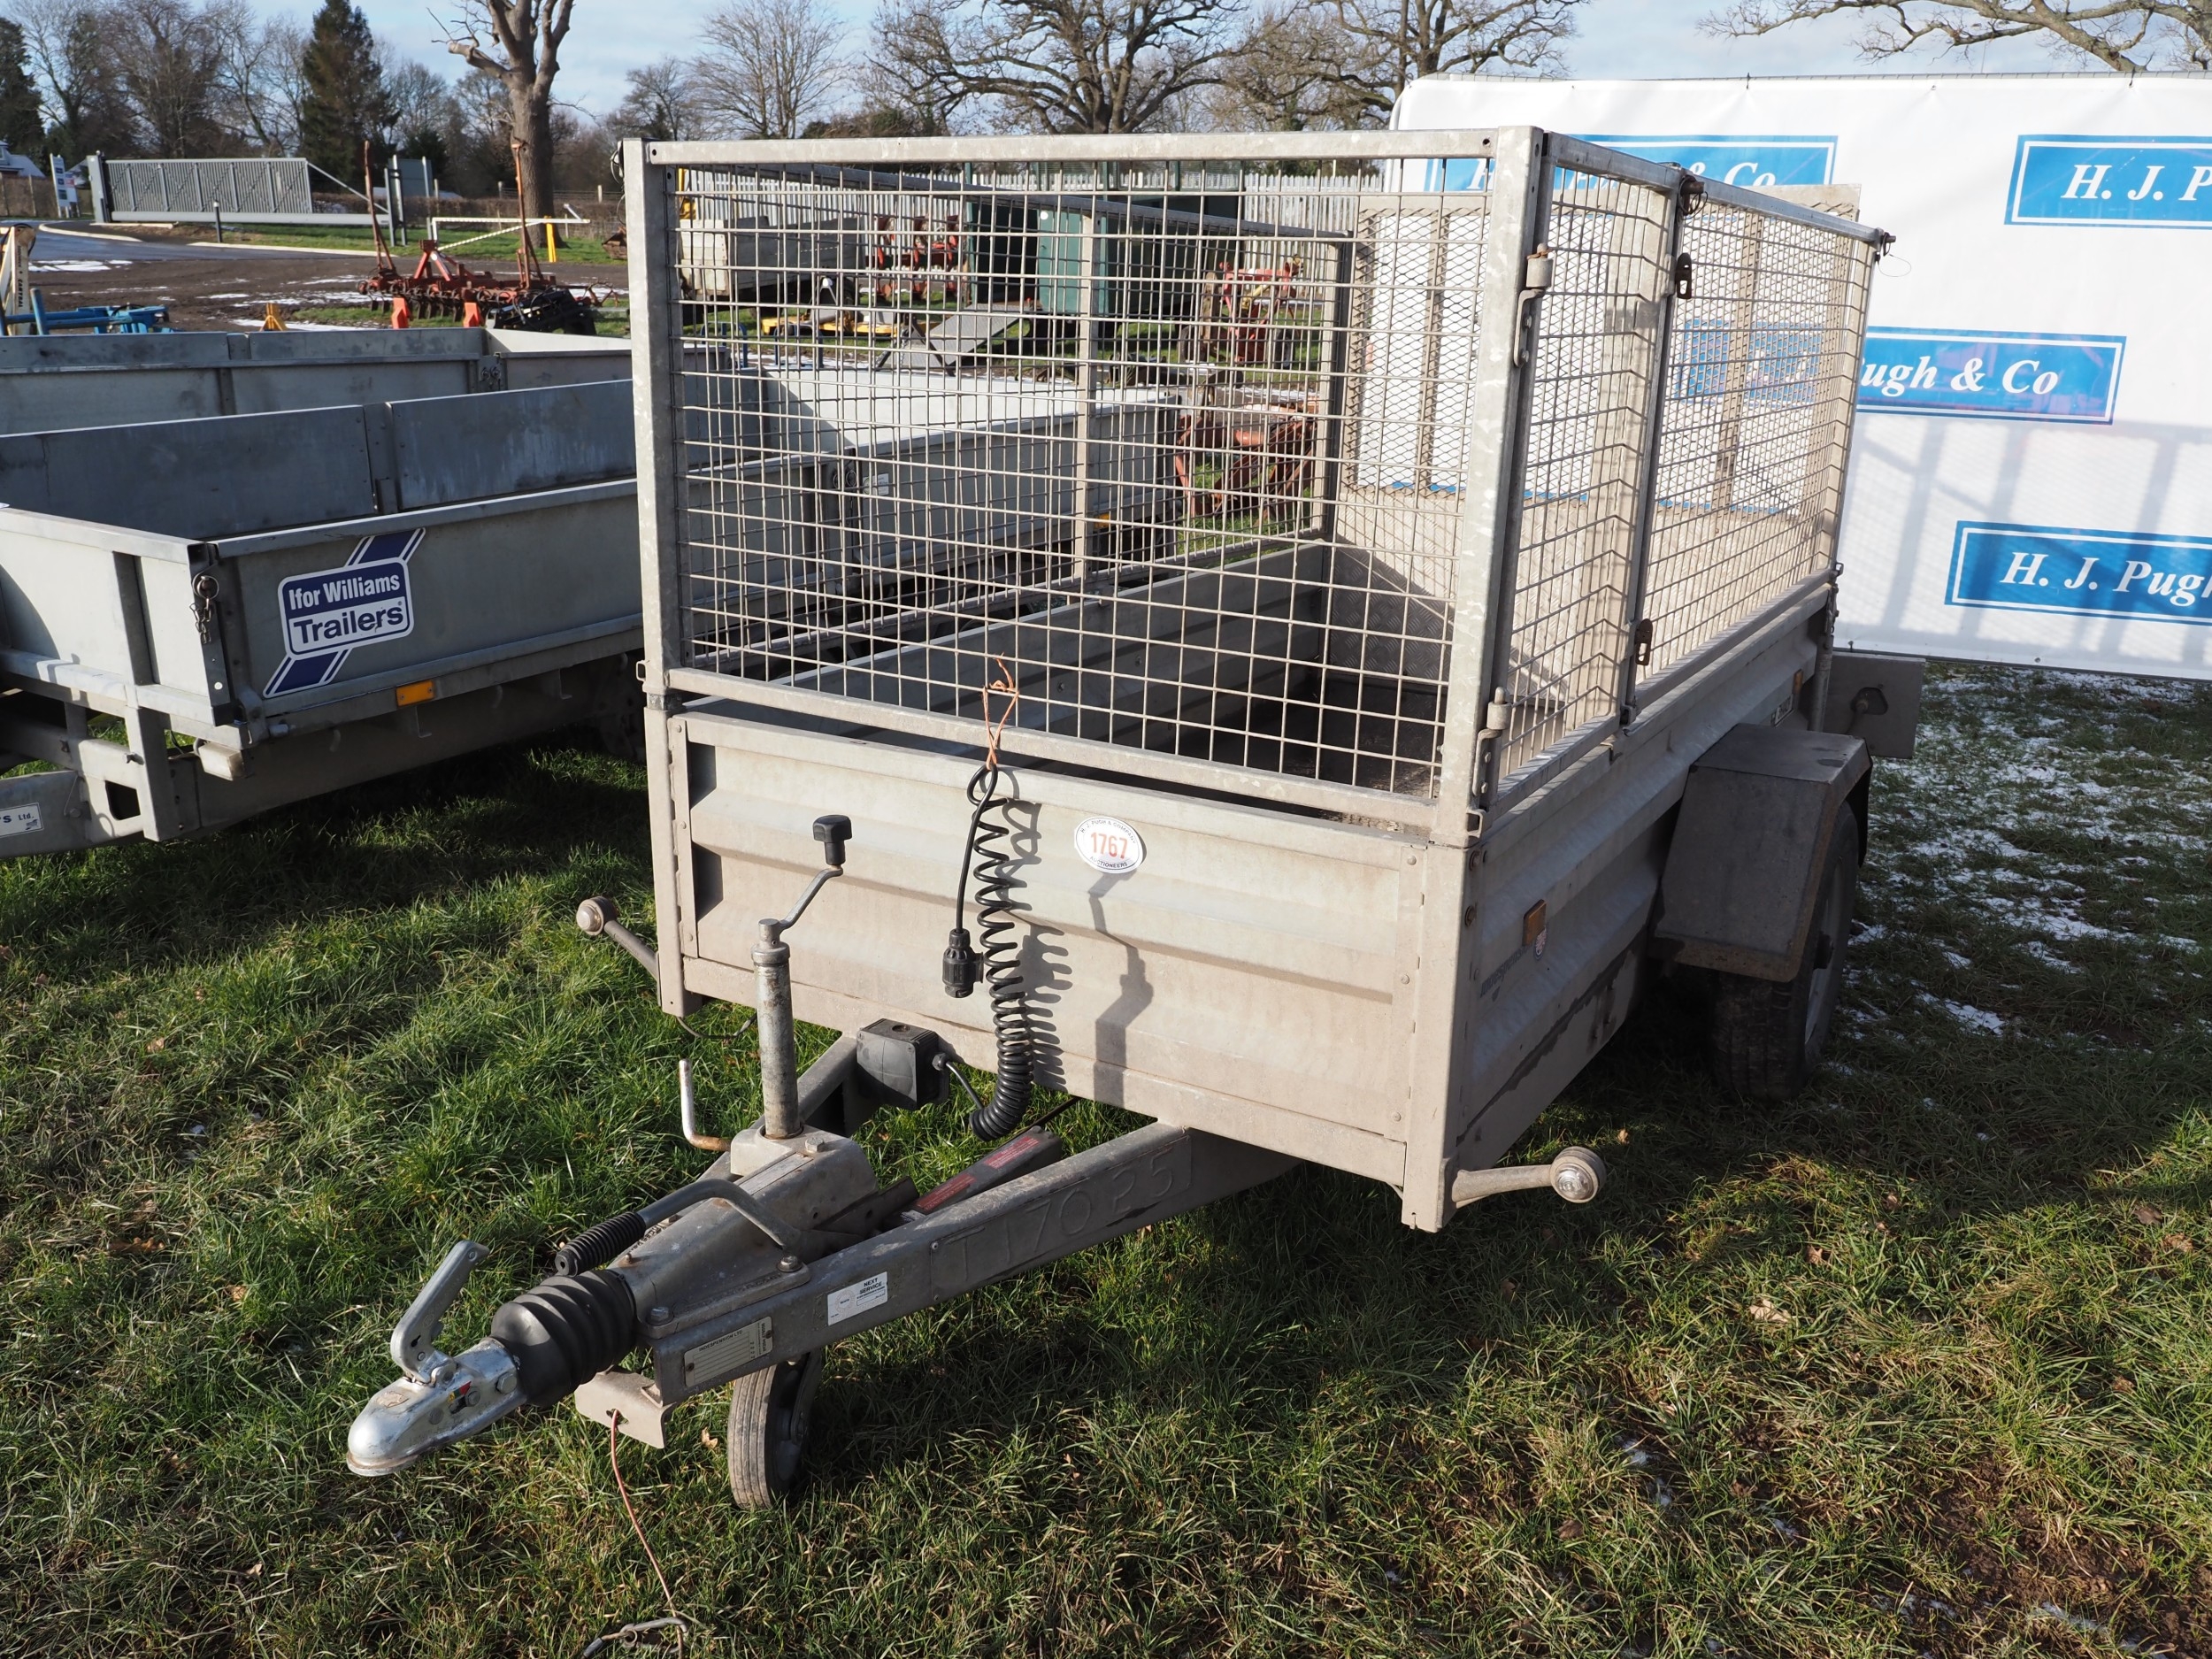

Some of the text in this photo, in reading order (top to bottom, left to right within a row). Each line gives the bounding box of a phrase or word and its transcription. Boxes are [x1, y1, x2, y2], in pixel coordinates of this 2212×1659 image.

[2060, 165, 2113, 200] H.
[2127, 165, 2165, 201] J.
[1861, 356, 1938, 397] ugh
[1950, 357, 1985, 392] &
[2001, 359, 2059, 395] Co
[1999, 551, 2049, 587] H.
[2063, 557, 2100, 590] J.
[288, 574, 401, 611] Ifor Williams
[293, 605, 404, 644] Trailers
[18, 812, 35, 821] Ltd.
[1090, 832, 1128, 859] 1767
[1089, 856, 1128, 868] AUCTIONEERS
[859, 1280, 883, 1294] SERVICE
[864, 1277, 879, 1287] NEXT
[698, 1334, 734, 1352] INDESPENSION
[733, 1329, 743, 1338] LTD
